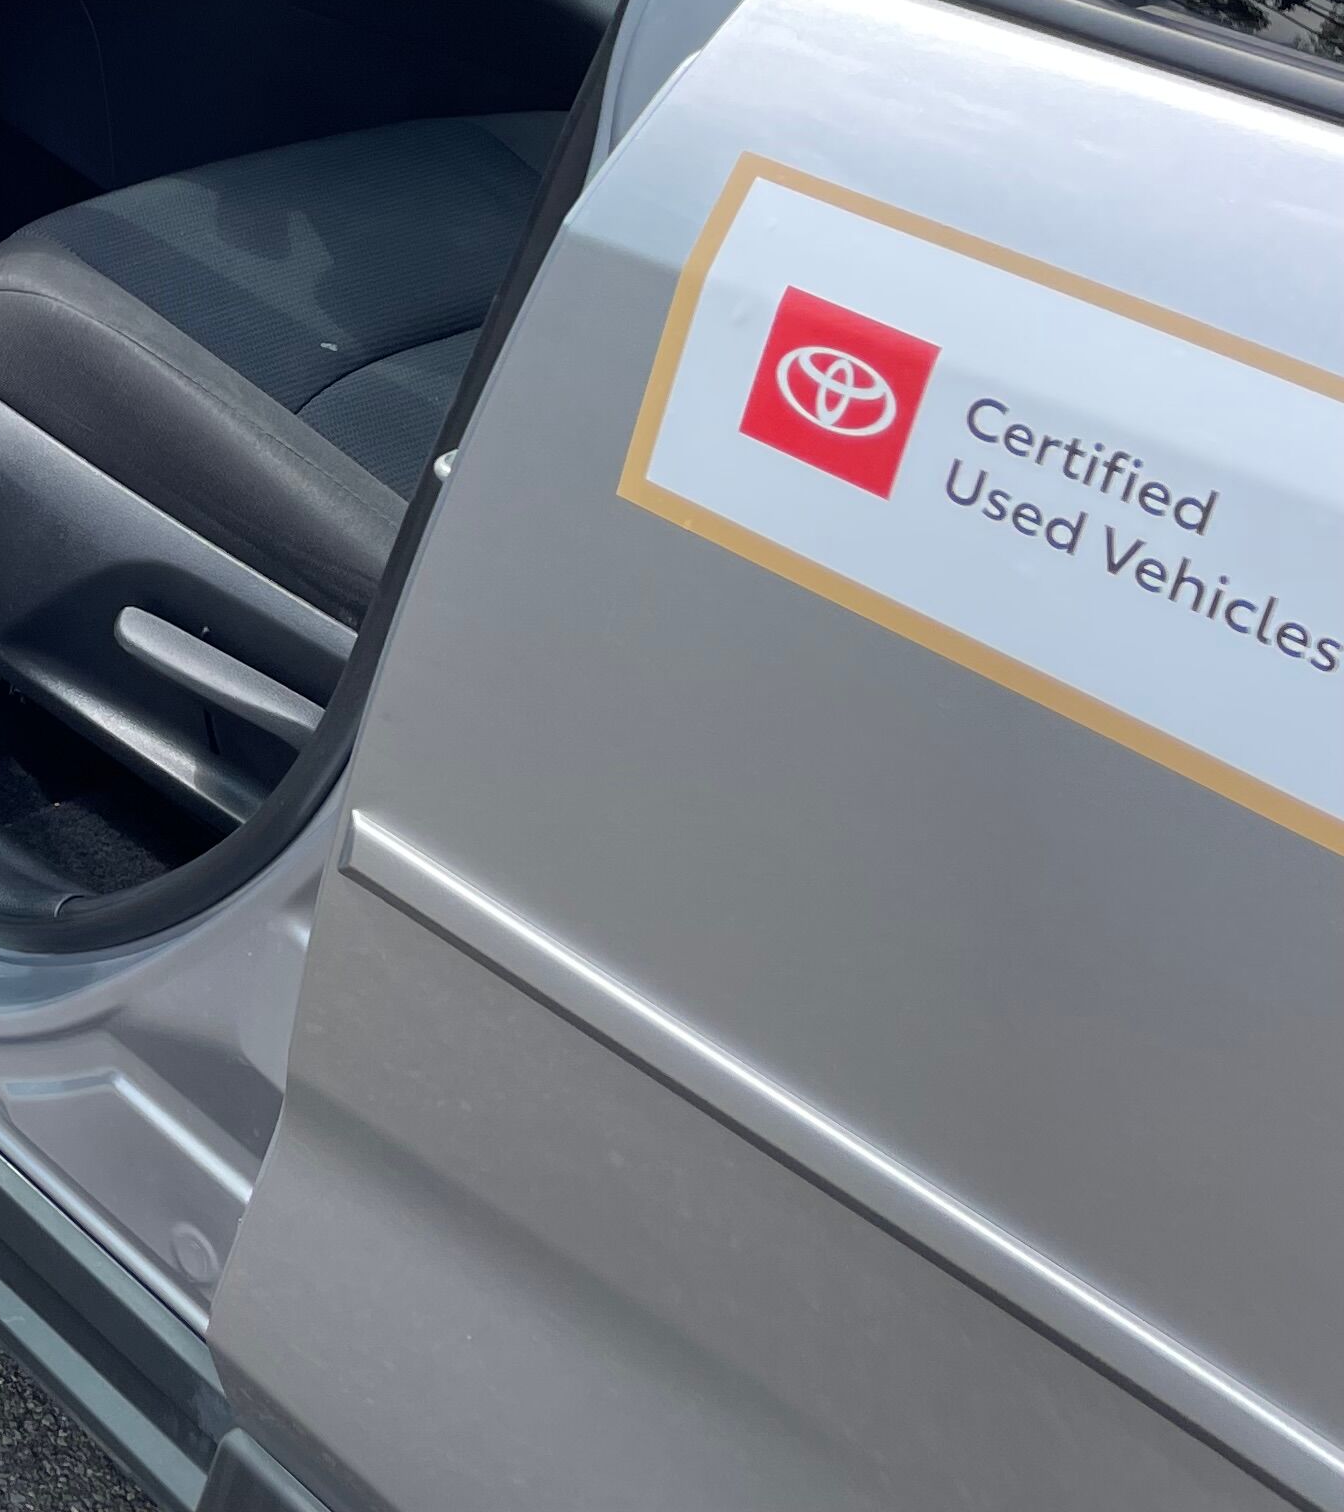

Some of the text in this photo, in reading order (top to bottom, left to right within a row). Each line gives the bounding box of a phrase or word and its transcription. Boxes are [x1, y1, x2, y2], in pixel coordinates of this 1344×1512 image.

[966, 397, 1220, 536] Certified
[945, 458, 1343, 673] Used Vehicles
